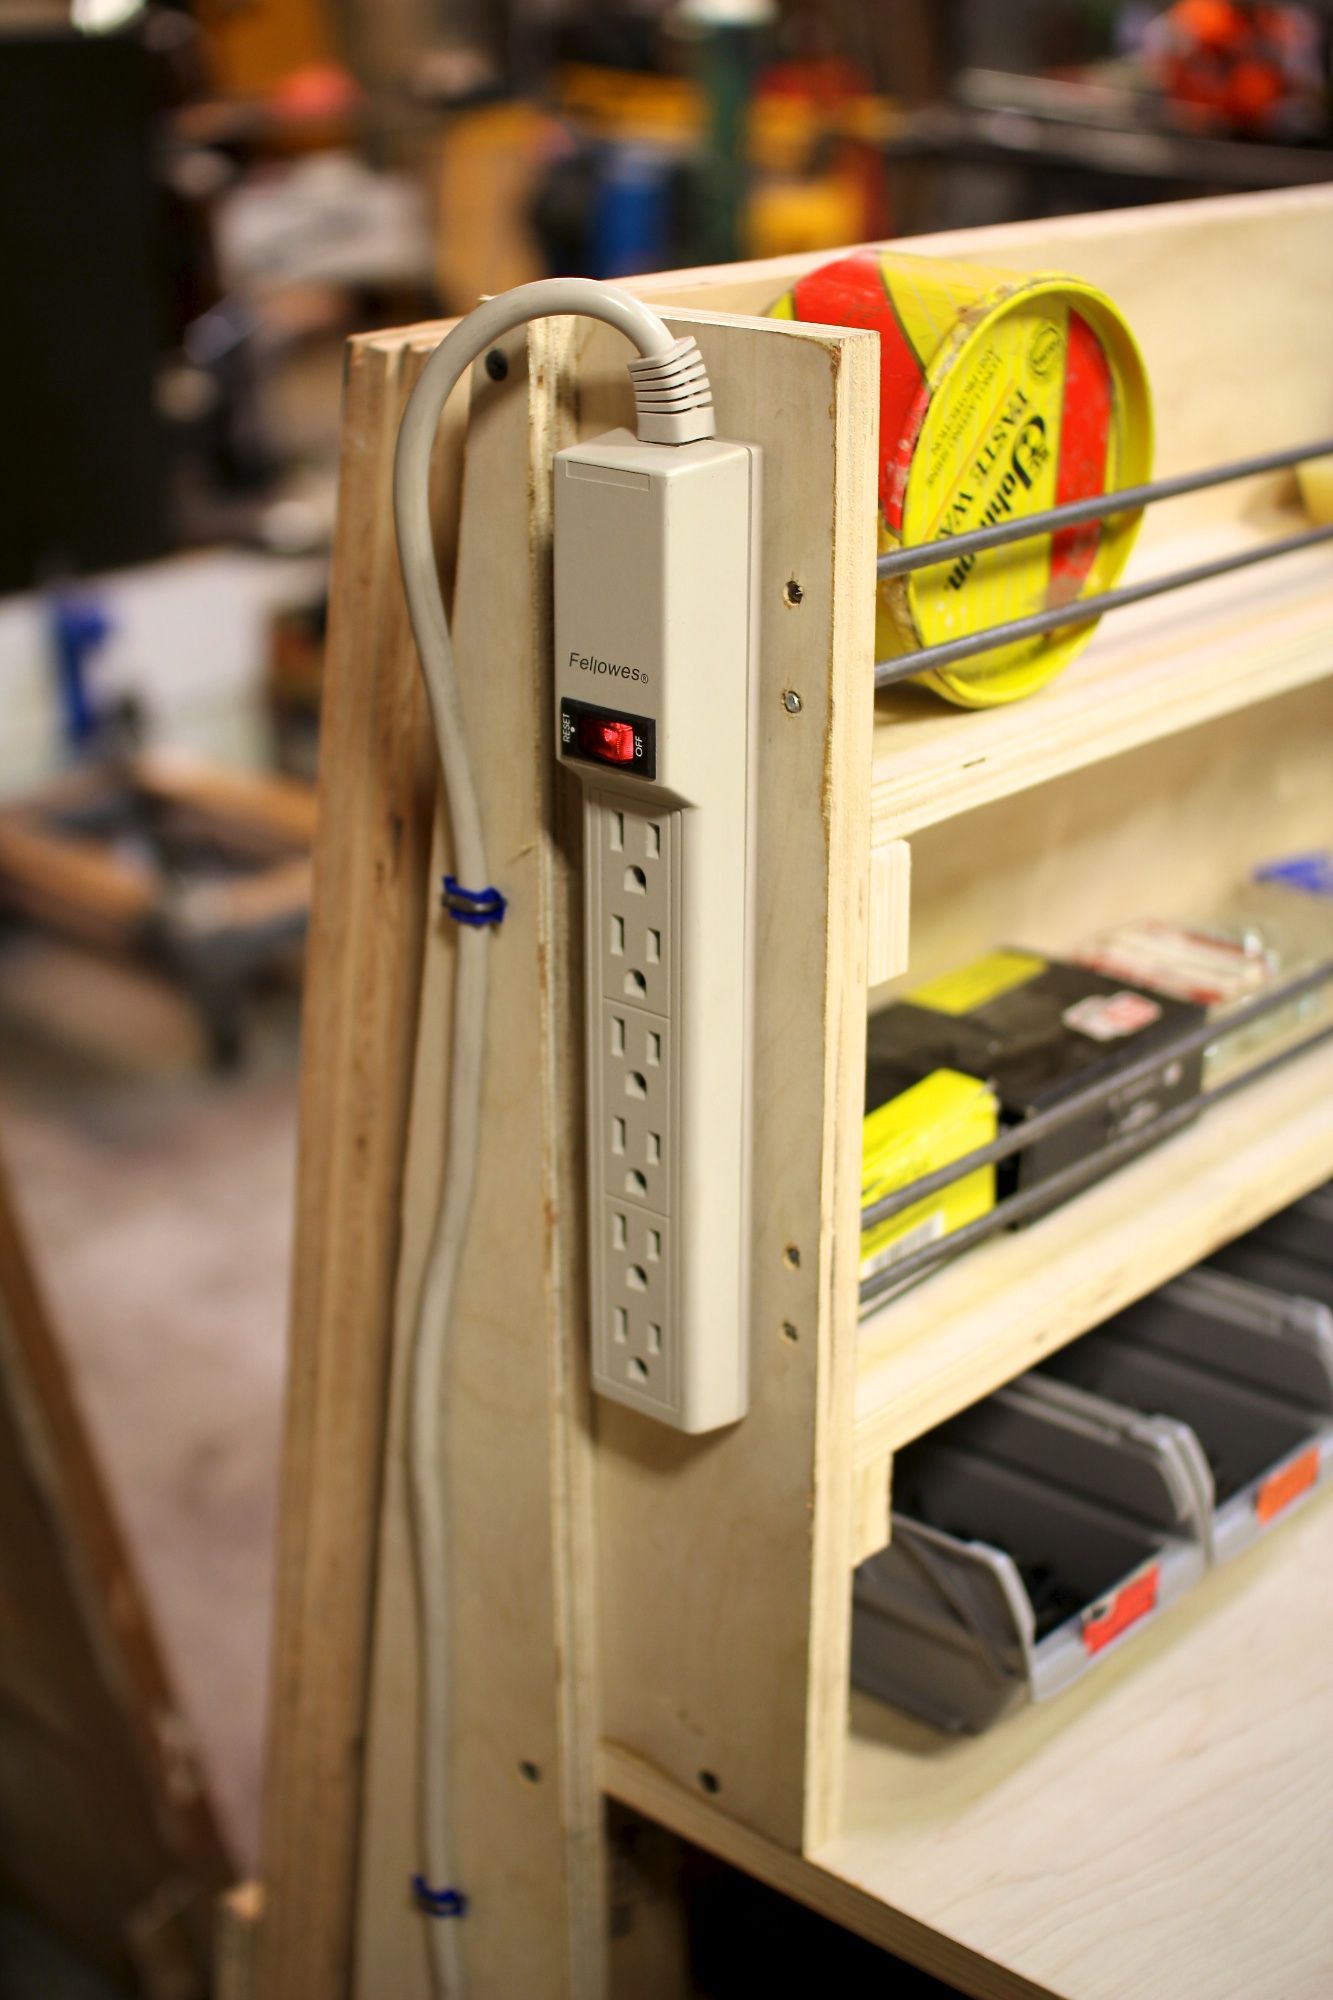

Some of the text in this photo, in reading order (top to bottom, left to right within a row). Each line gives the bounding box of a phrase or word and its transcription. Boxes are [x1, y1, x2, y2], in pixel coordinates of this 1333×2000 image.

[969, 390, 1028, 485] PASTE
[562, 713, 570, 743] RESET
[635, 735, 643, 758] OFF
